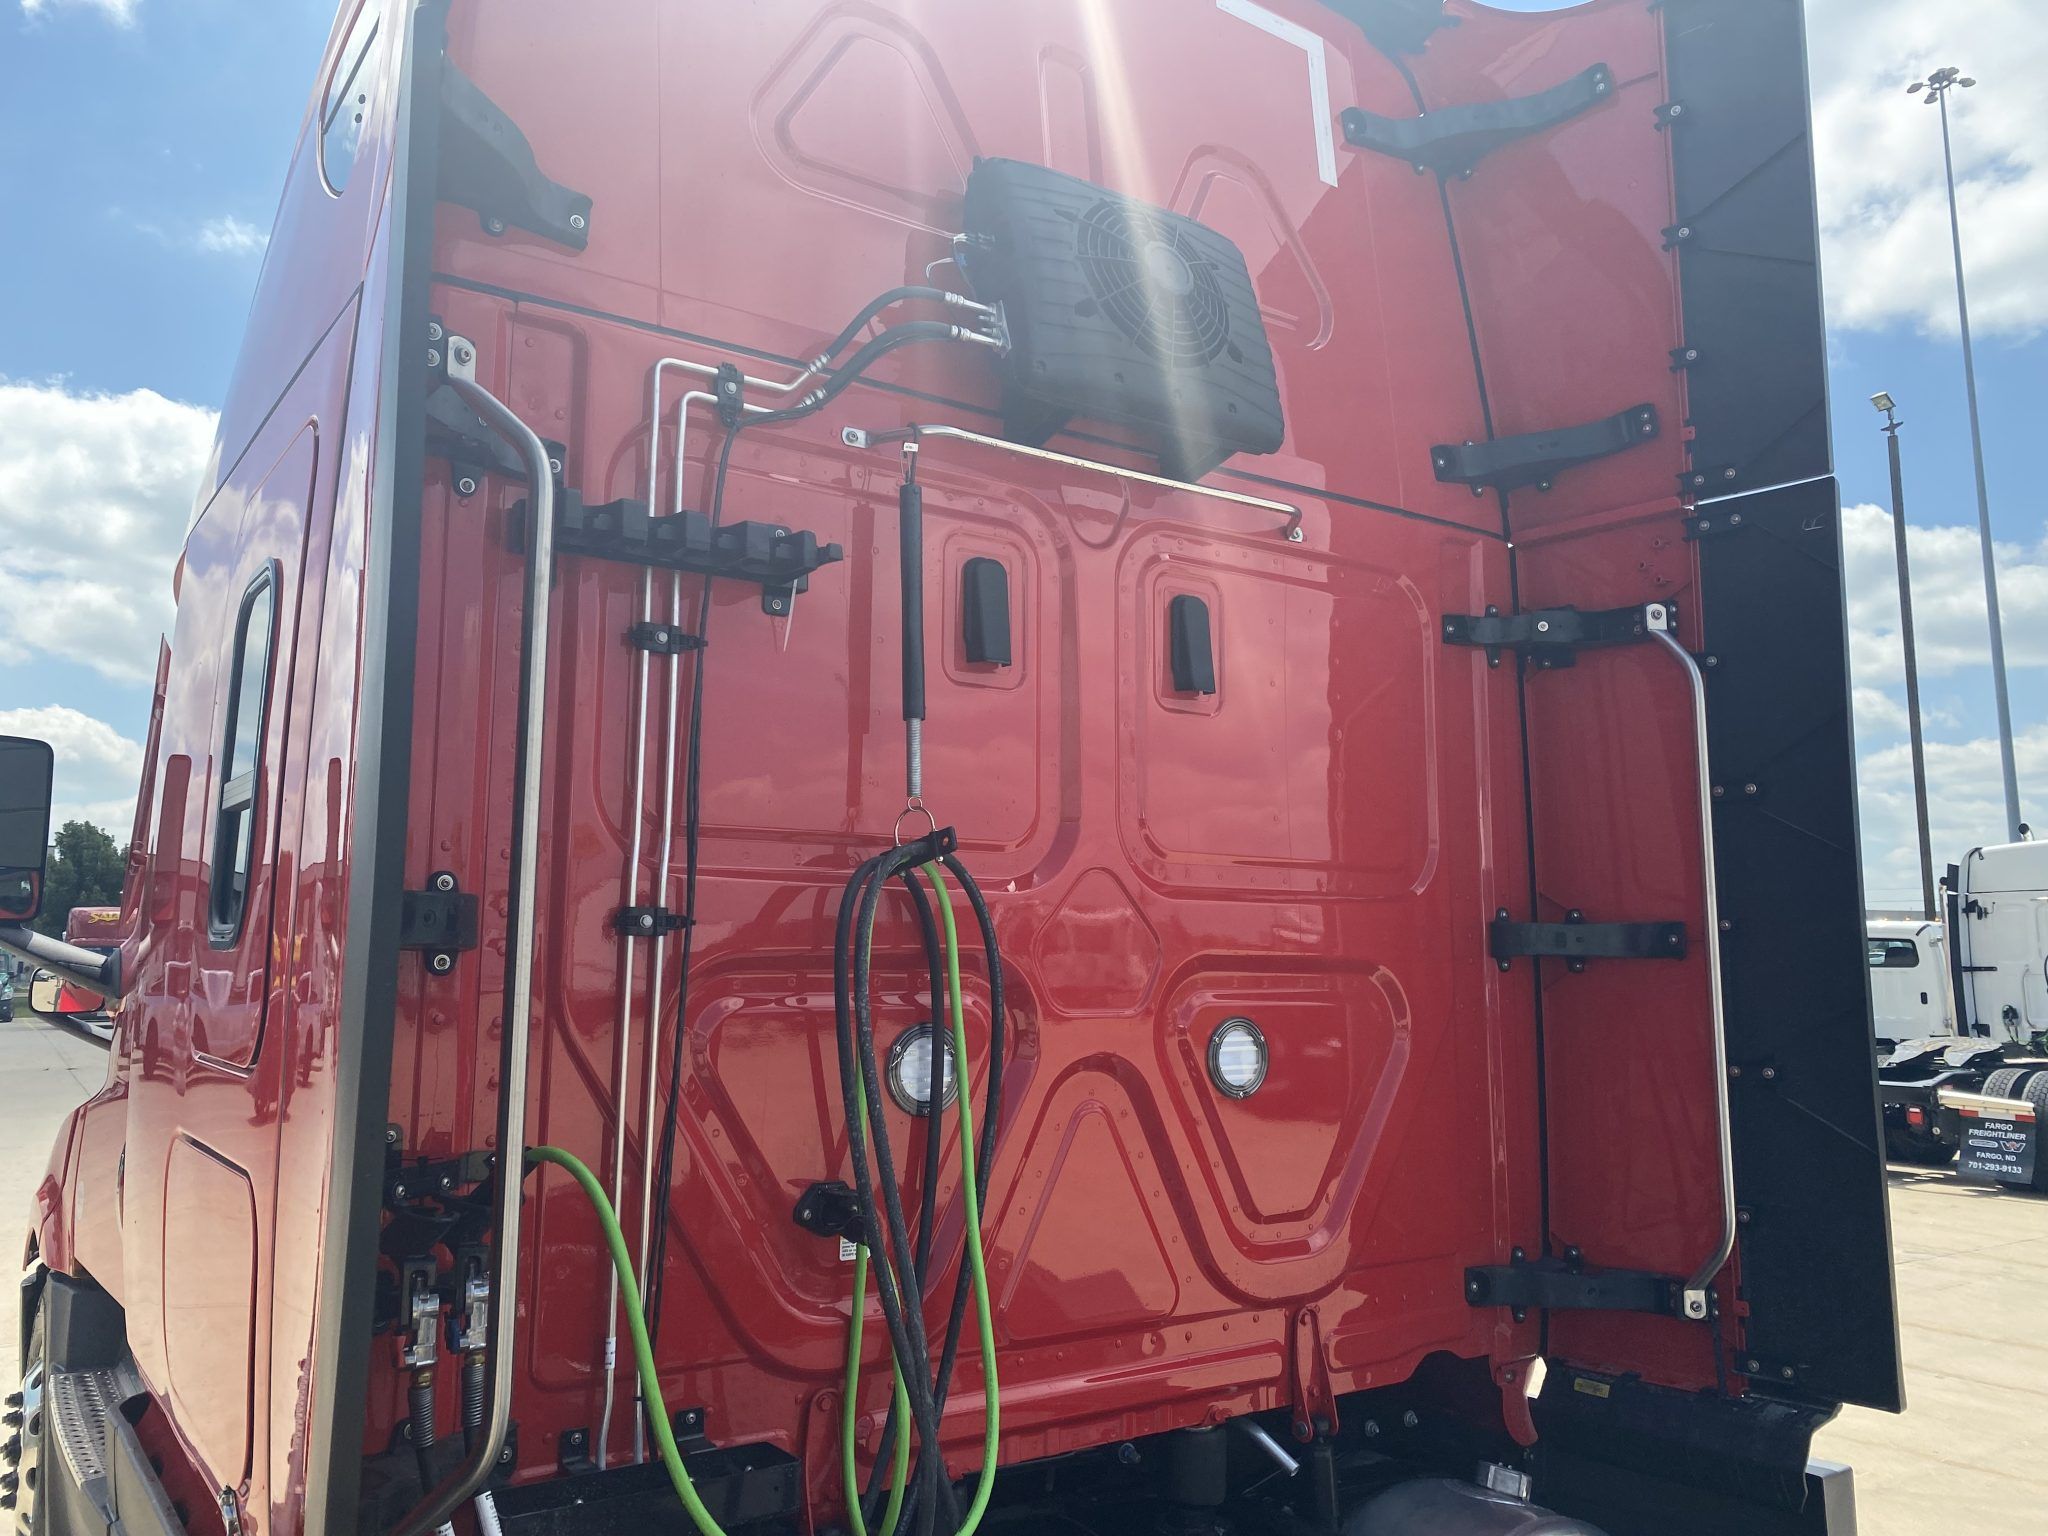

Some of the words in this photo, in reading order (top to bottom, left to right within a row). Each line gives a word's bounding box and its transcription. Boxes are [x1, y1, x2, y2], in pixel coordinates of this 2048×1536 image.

[1985, 1122, 2013, 1131] FARGO
[1968, 1129, 2026, 1140] FREIGHTLINER
[1976, 1152, 2003, 1161] FARGO,
[1968, 1161, 2022, 1173] 701-293-9133
